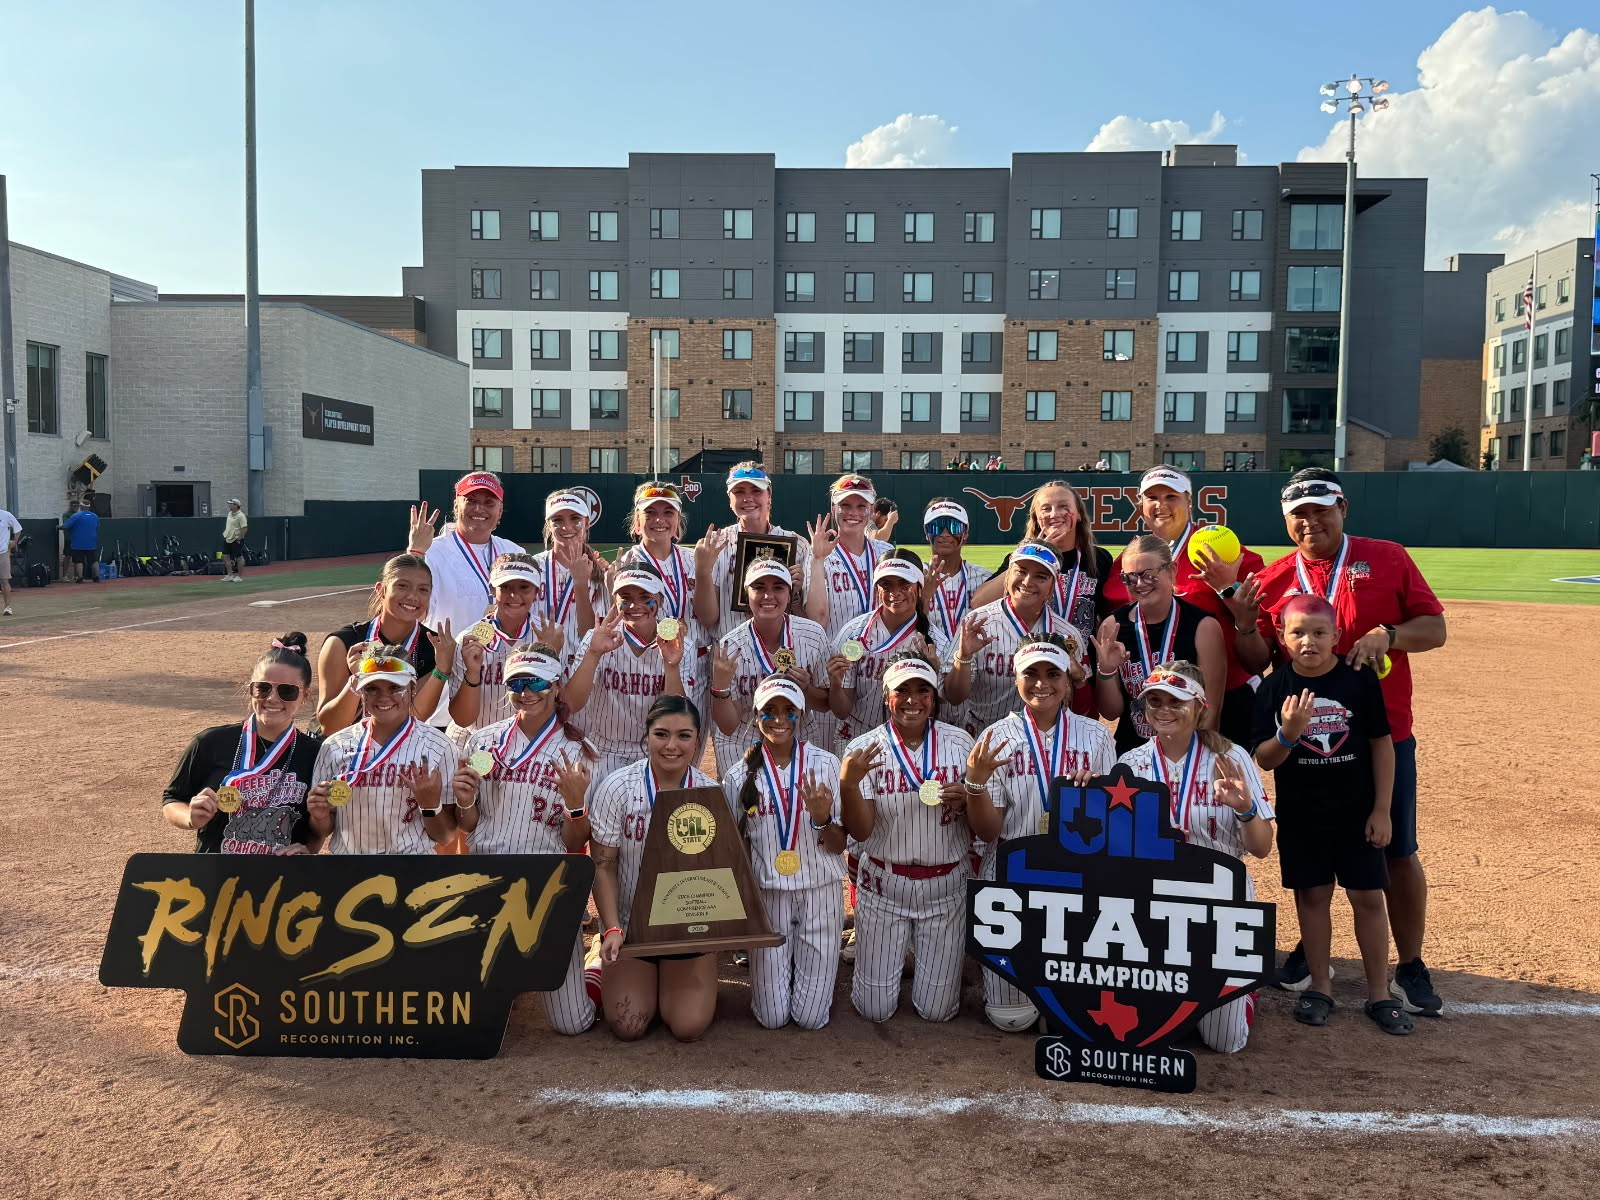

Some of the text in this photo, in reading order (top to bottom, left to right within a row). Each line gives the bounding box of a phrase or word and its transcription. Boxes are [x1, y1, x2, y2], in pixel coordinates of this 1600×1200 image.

[684, 483, 699, 492] 200
[1072, 486, 1228, 532] EXS
[603, 667, 665, 697] COAHOM
[532, 795, 565, 828] 22
[676, 812, 706, 837] UIL
[682, 836, 702, 844] STATE
[1208, 817, 1217, 841] 1
[973, 886, 1264, 973] STATE
[1045, 959, 1189, 994] CHAMPIONS
[280, 990, 471, 1026] SOUTHERN
[280, 1034, 420, 1045] RECOGNITION INC.
[1081, 1048, 1185, 1077] SOUTHERN
[1081, 1071, 1158, 1085] RECOGNITION INC.
